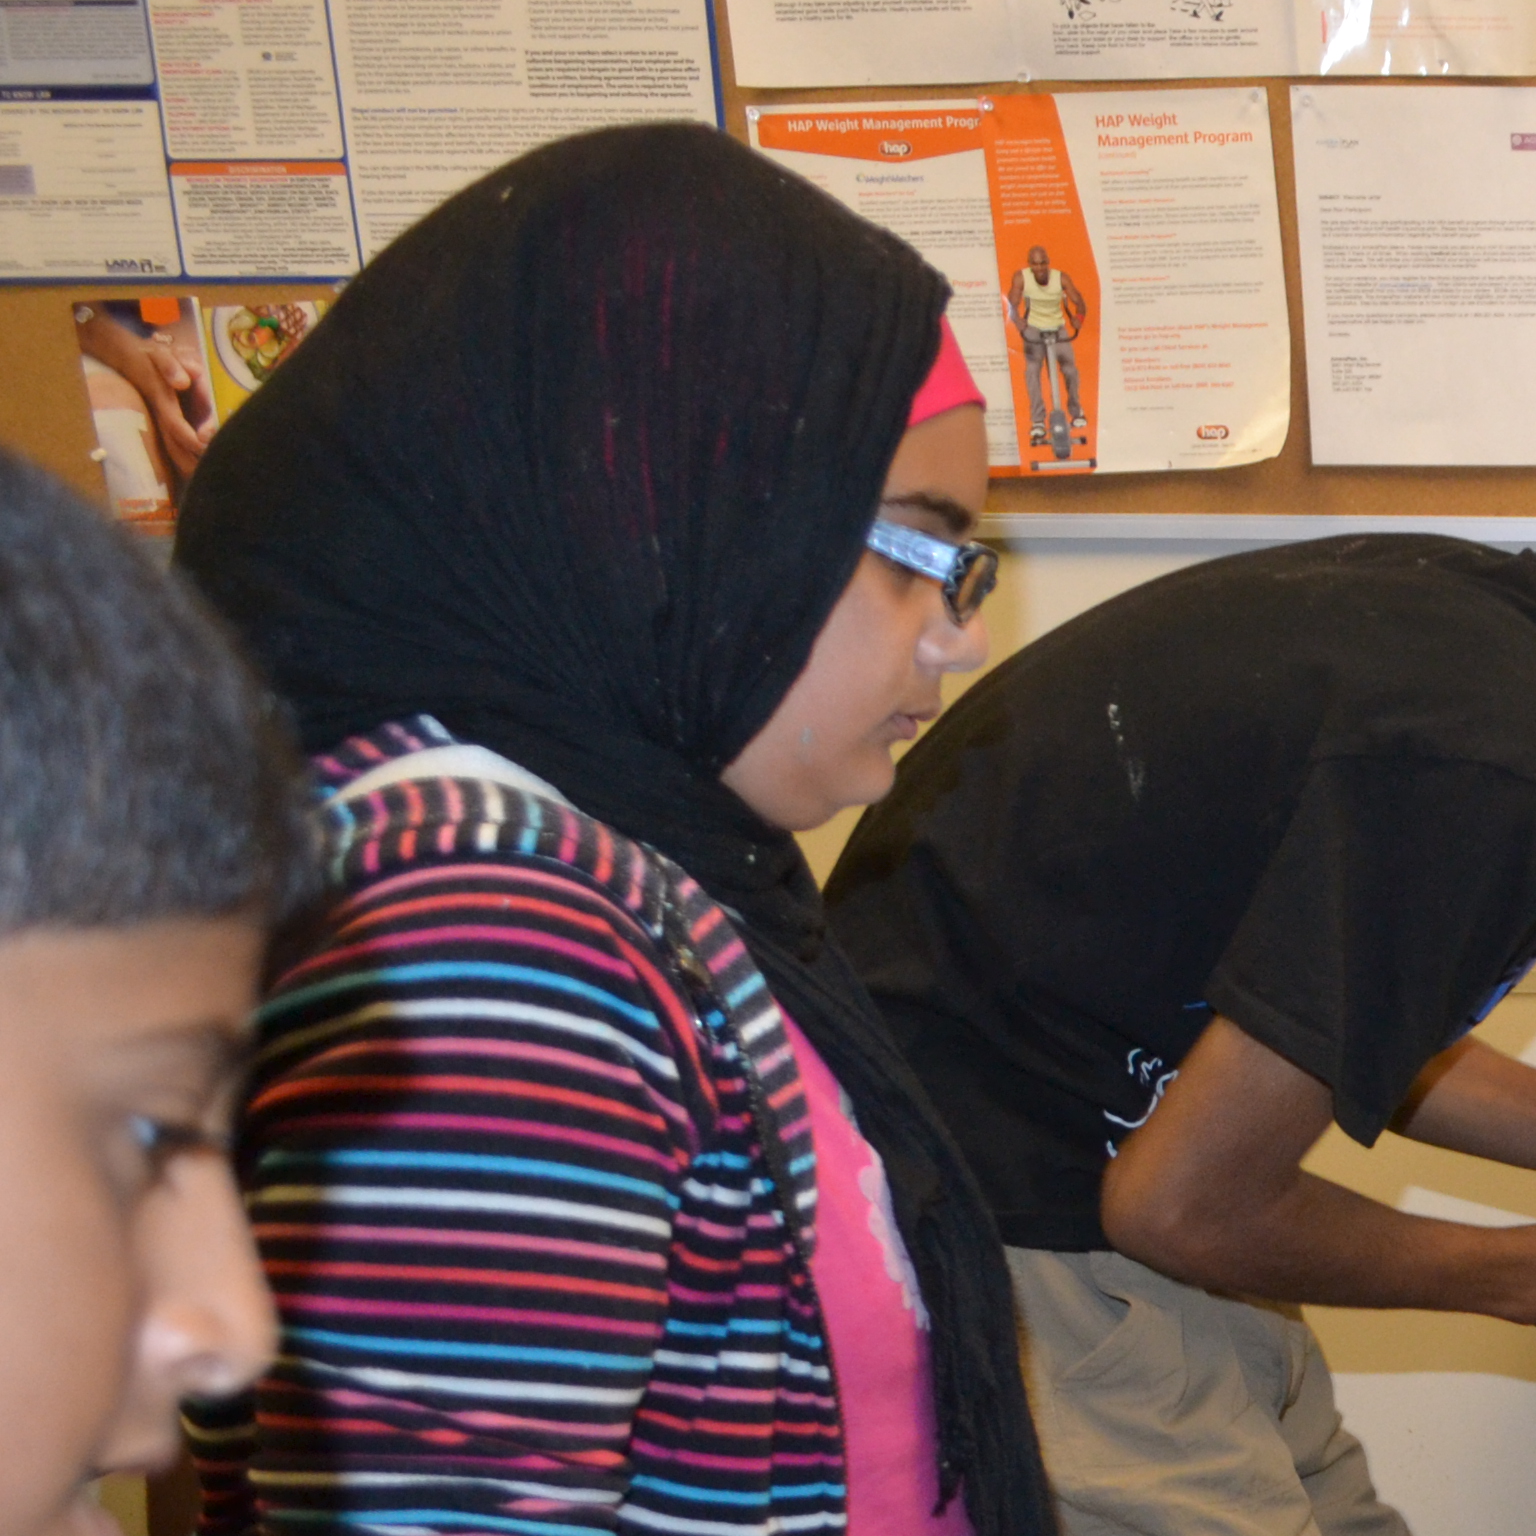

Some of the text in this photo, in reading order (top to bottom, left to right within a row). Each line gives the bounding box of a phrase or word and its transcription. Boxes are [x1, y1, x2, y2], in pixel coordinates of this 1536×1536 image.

[788, 115, 981, 134] HAP Weight Management Progr
[1096, 112, 1178, 129] HAP Weight
[1098, 130, 1253, 148] Management Program
[884, 141, 908, 156] hap
[953, 279, 987, 289] Program
[1202, 425, 1225, 439] hap
